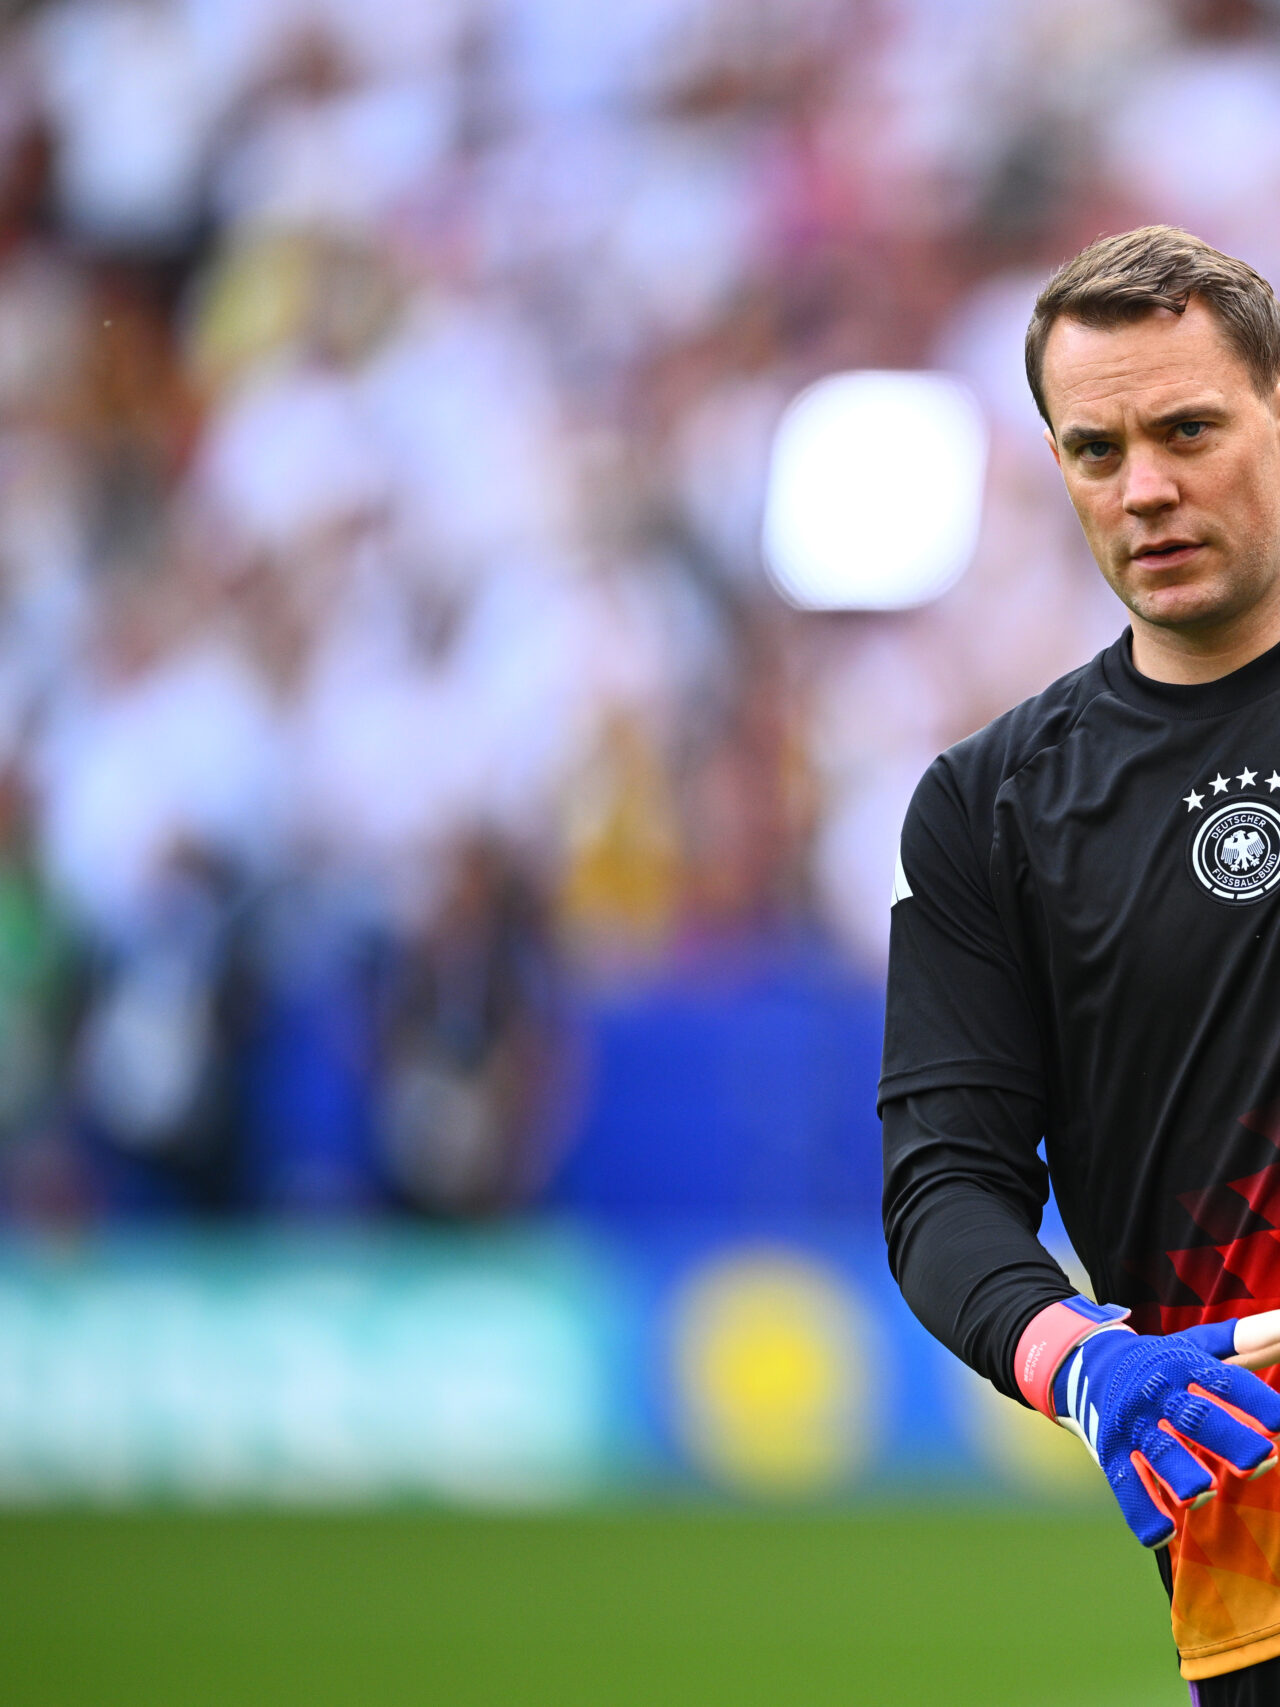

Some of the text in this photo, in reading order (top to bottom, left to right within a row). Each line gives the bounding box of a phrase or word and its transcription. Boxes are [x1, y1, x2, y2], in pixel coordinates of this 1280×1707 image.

[1211, 814, 1267, 840] DEUTSCHER
[1212, 853, 1277, 888] FUSSBALL-BUND
[1024, 1343, 1037, 1382] NEUER
